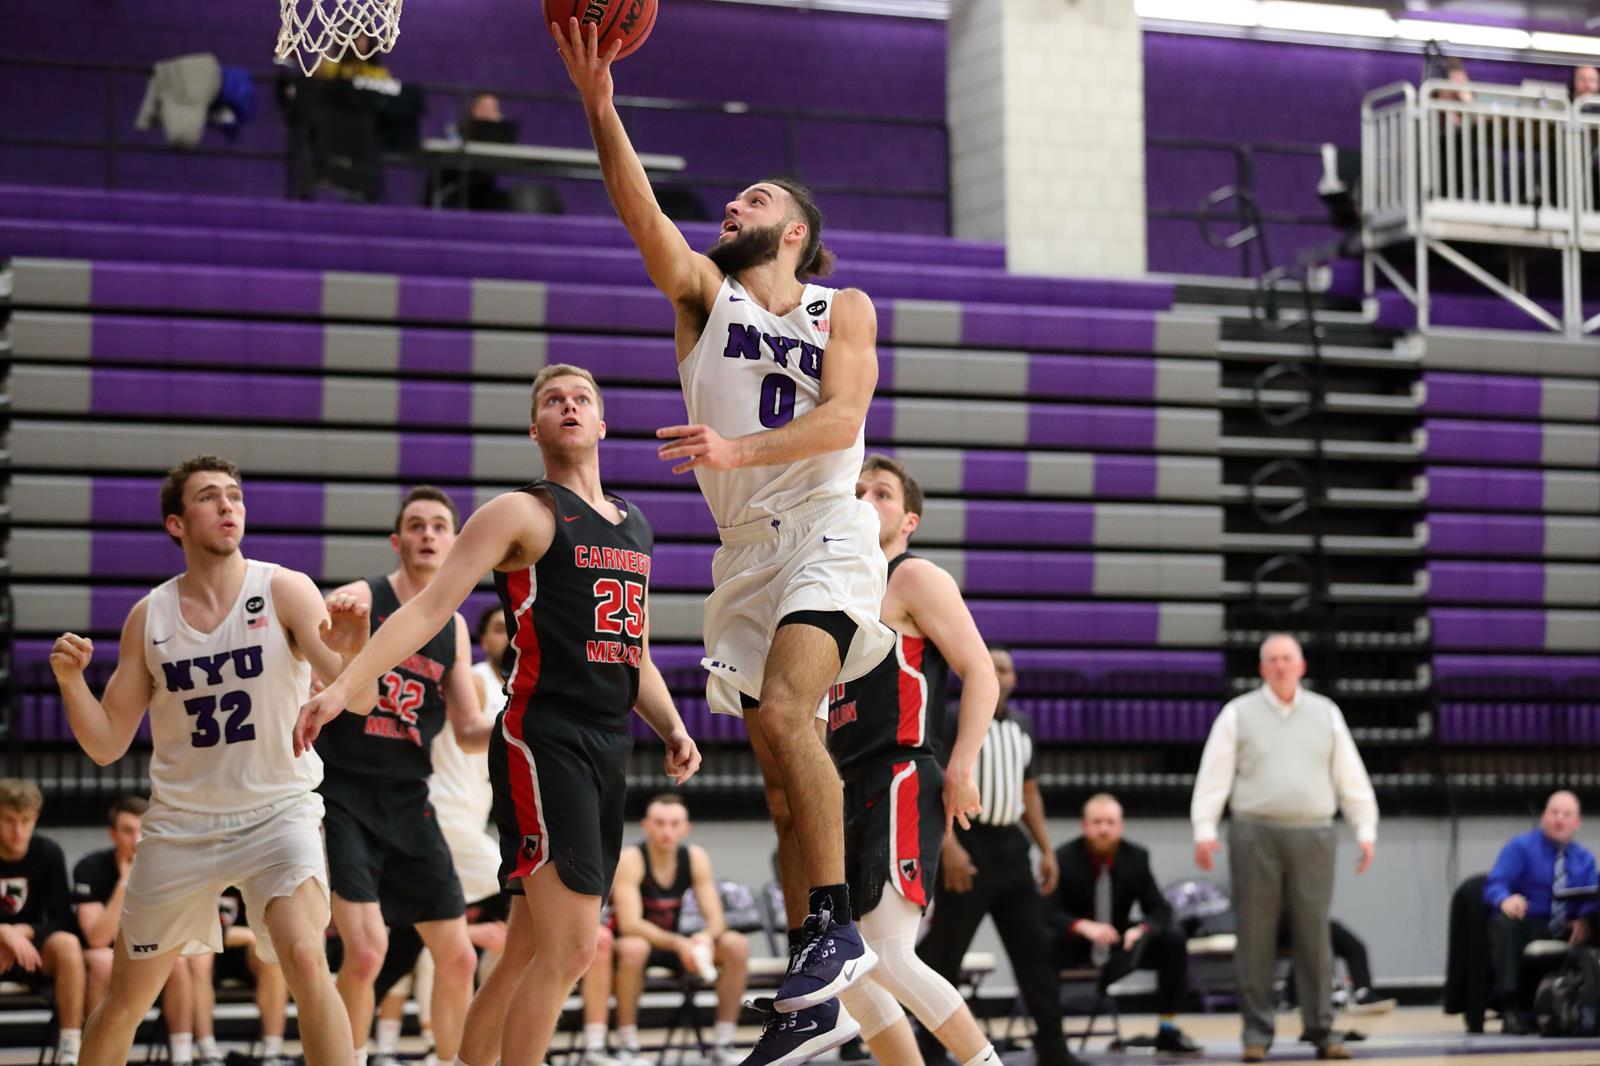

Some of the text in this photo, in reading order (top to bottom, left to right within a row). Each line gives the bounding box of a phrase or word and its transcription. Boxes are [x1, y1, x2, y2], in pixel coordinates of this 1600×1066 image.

[723, 322, 824, 380] NYU
[759, 372, 797, 429] 0
[593, 577, 644, 638] 25
[162, 645, 264, 693] NYU
[184, 690, 256, 748] 32
[376, 671, 426, 726] 32
